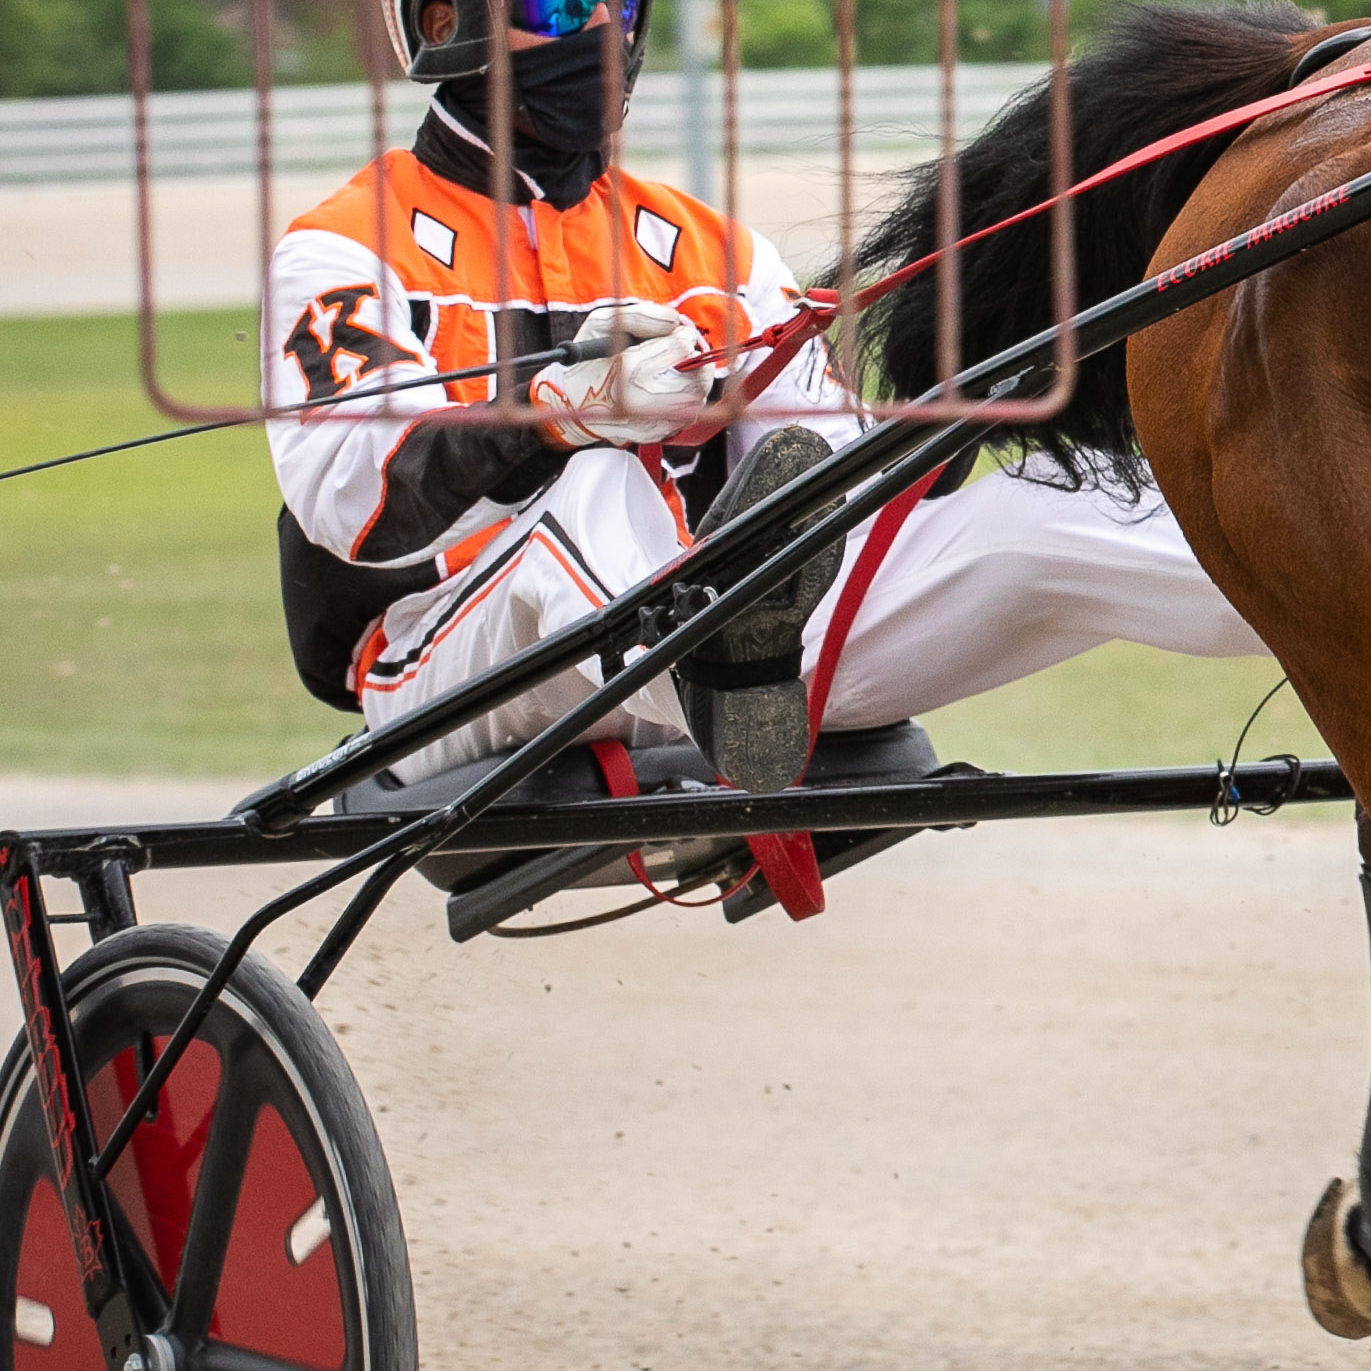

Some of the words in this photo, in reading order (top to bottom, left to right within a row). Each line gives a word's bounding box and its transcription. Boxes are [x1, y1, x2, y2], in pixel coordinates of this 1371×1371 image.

[1155, 241, 1236, 293] ECURIE
[1247, 185, 1351, 250] MAGUIRE
[282, 281, 425, 426] K
